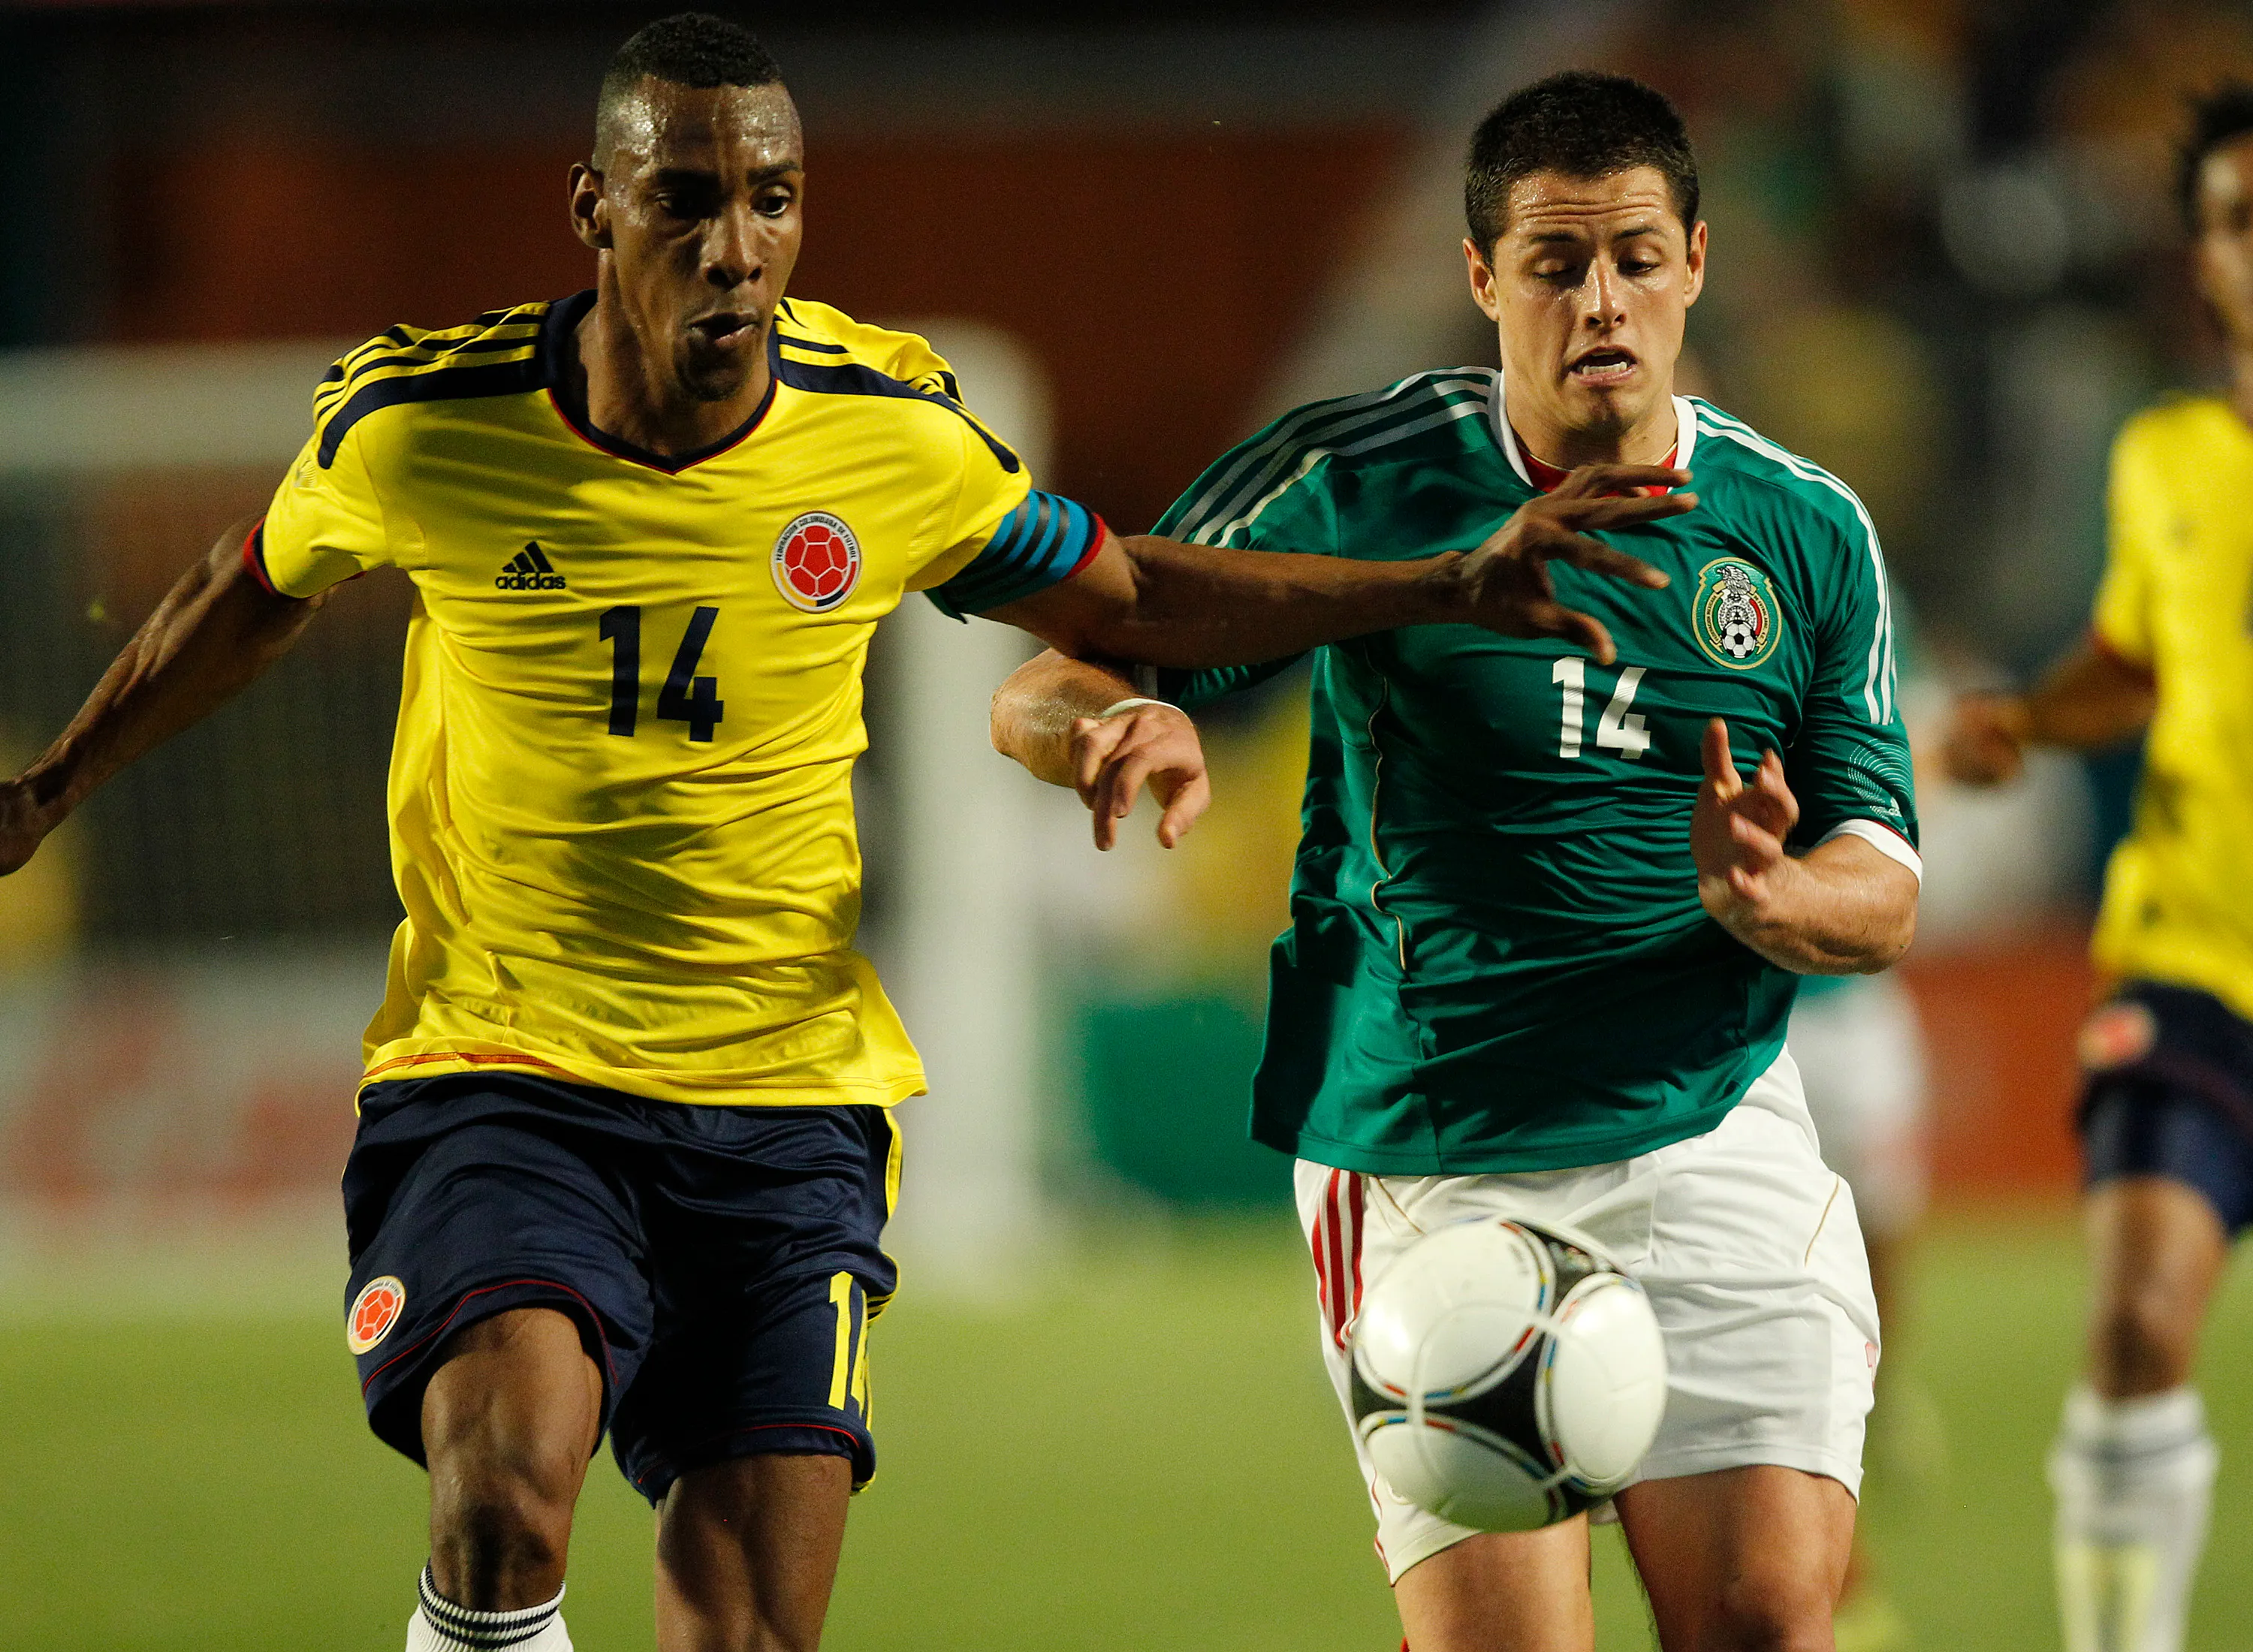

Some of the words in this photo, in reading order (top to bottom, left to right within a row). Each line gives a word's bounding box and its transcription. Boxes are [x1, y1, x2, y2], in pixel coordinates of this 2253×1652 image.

[495, 572, 566, 591] adidas
[599, 605, 724, 743] 14
[1552, 656, 1651, 759] 14
